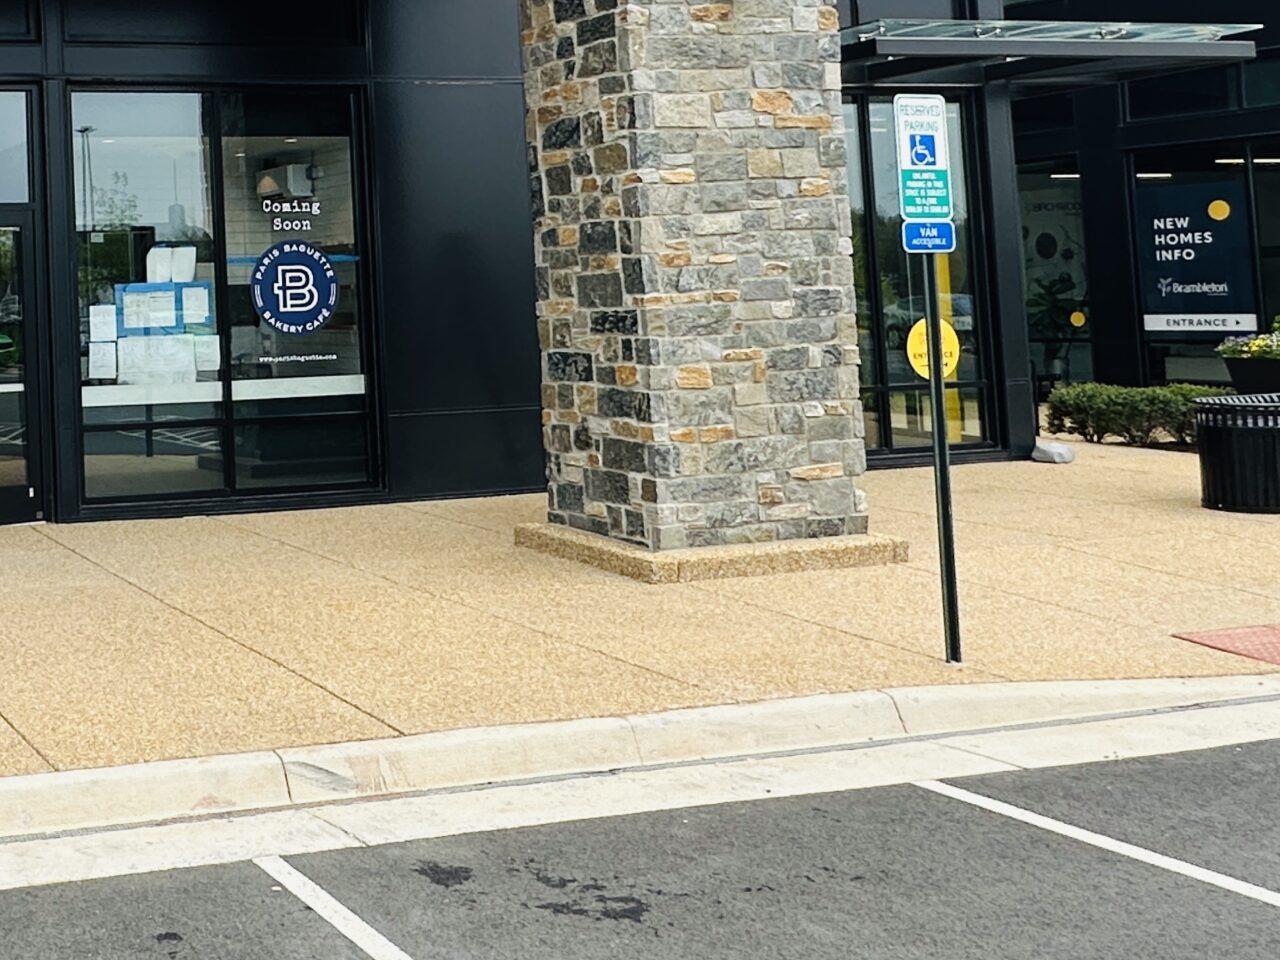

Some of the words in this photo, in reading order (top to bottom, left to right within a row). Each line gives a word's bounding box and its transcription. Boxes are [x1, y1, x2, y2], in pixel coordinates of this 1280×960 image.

[900, 104, 941, 117] RESERVED
[904, 120, 939, 133] PARKING
[262, 199, 321, 215] Coming
[272, 217, 312, 231] Soon
[1153, 216, 1190, 230] NEW
[919, 227, 938, 238] VAN
[1154, 231, 1213, 246] HOMES
[255, 247, 281, 280] PARIS
[283, 243, 335, 279] BAGUETTE
[1155, 248, 1195, 262] INFO
[1171, 281, 1229, 294] Brambleton
[262, 309, 304, 334] BAKERY
[1166, 318, 1228, 327] ENTRANCE
